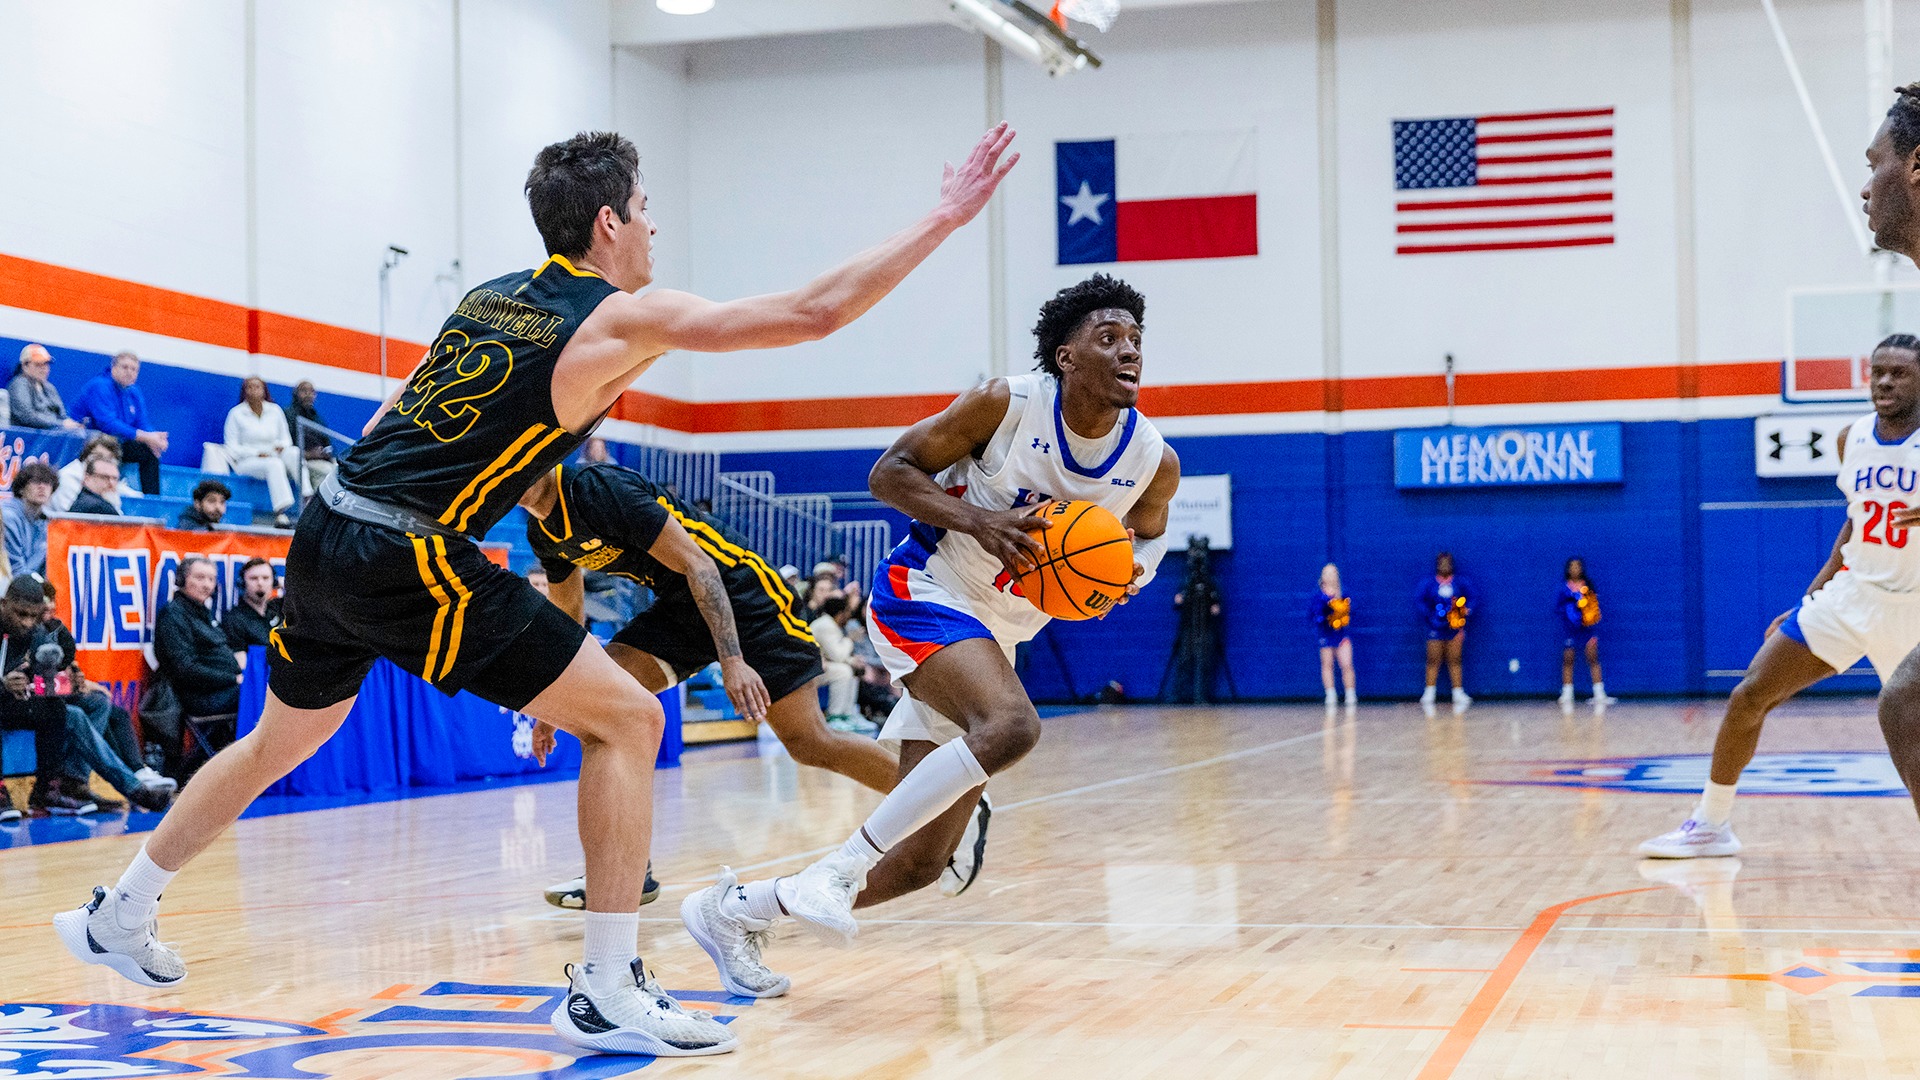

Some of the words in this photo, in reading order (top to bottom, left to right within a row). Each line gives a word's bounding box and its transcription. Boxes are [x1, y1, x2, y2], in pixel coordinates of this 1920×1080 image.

[400, 328, 514, 443] 22
[1420, 430, 1597, 463] MEMORIAL
[1420, 452, 1595, 485] HERMANN
[1854, 465, 1918, 495] HCU
